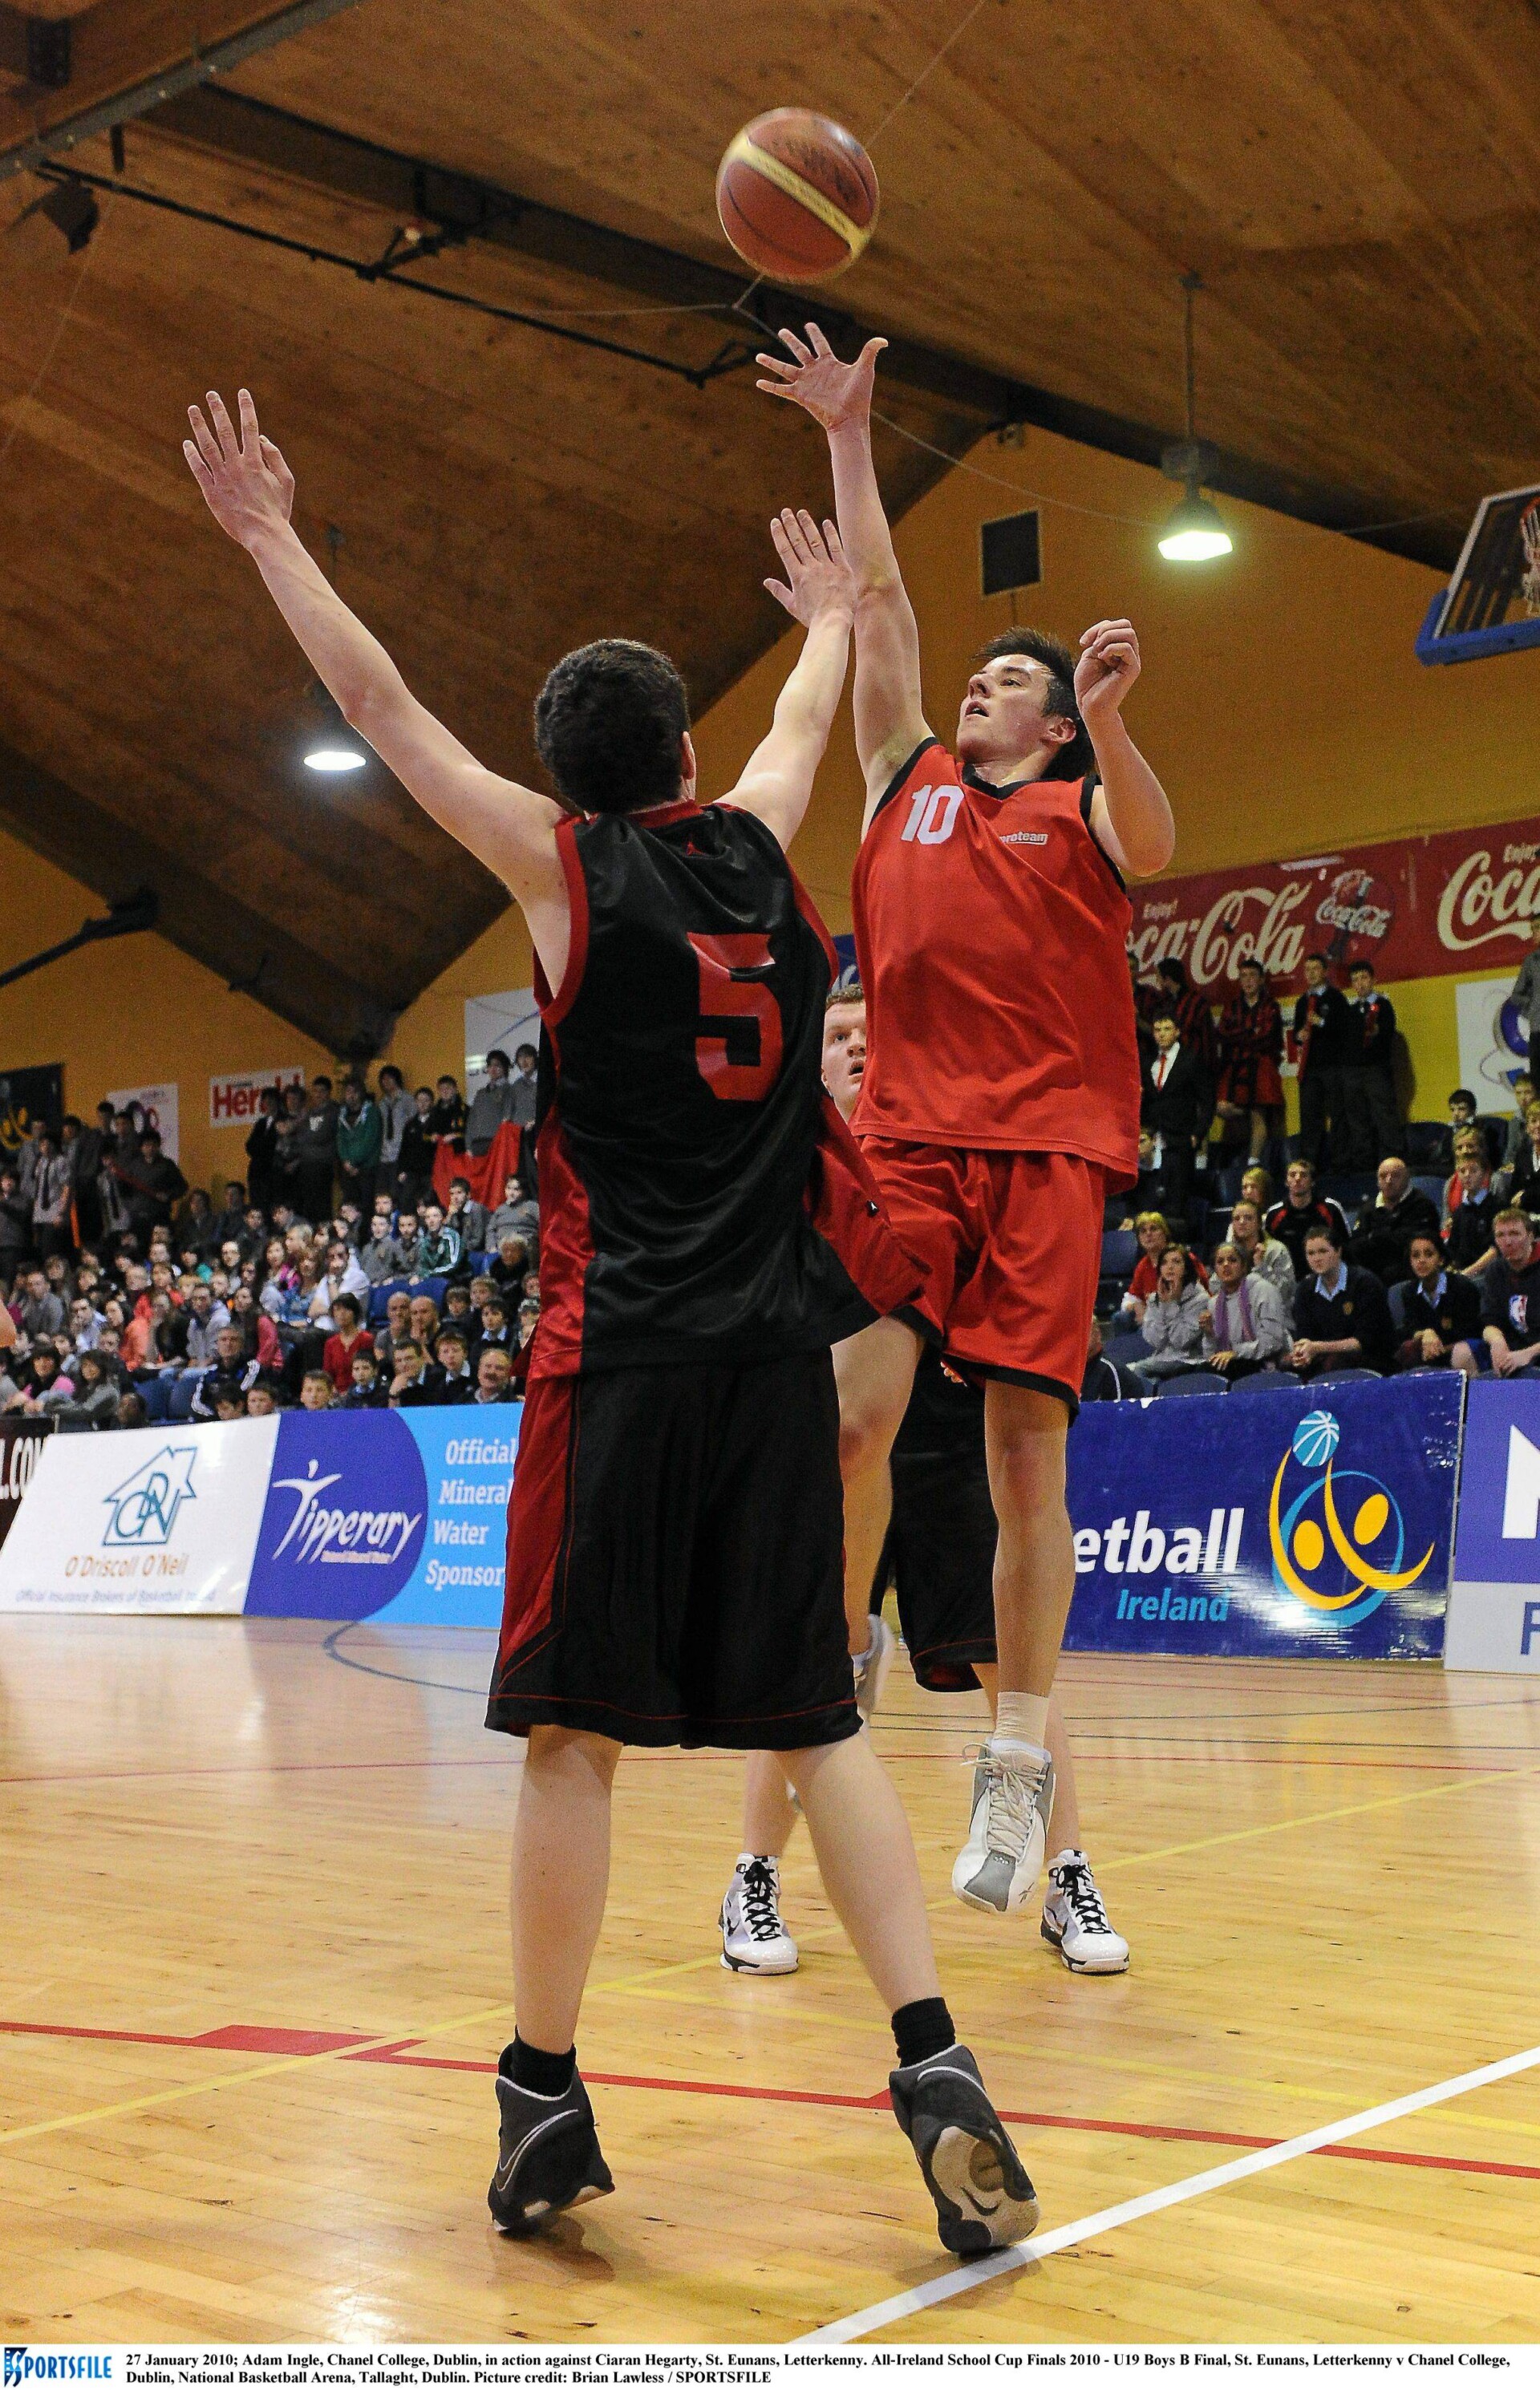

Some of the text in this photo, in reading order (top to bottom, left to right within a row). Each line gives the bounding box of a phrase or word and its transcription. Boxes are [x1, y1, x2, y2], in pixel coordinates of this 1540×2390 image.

[901, 784, 965, 845] 10
[687, 931, 784, 1101] 5
[445, 1438, 517, 1465] Official
[272, 1472, 423, 1564] Tipperary
[433, 1519, 490, 1545] Water
[425, 1559, 506, 1592] Sponsor
[1116, 1586, 1232, 1622] Ireland
